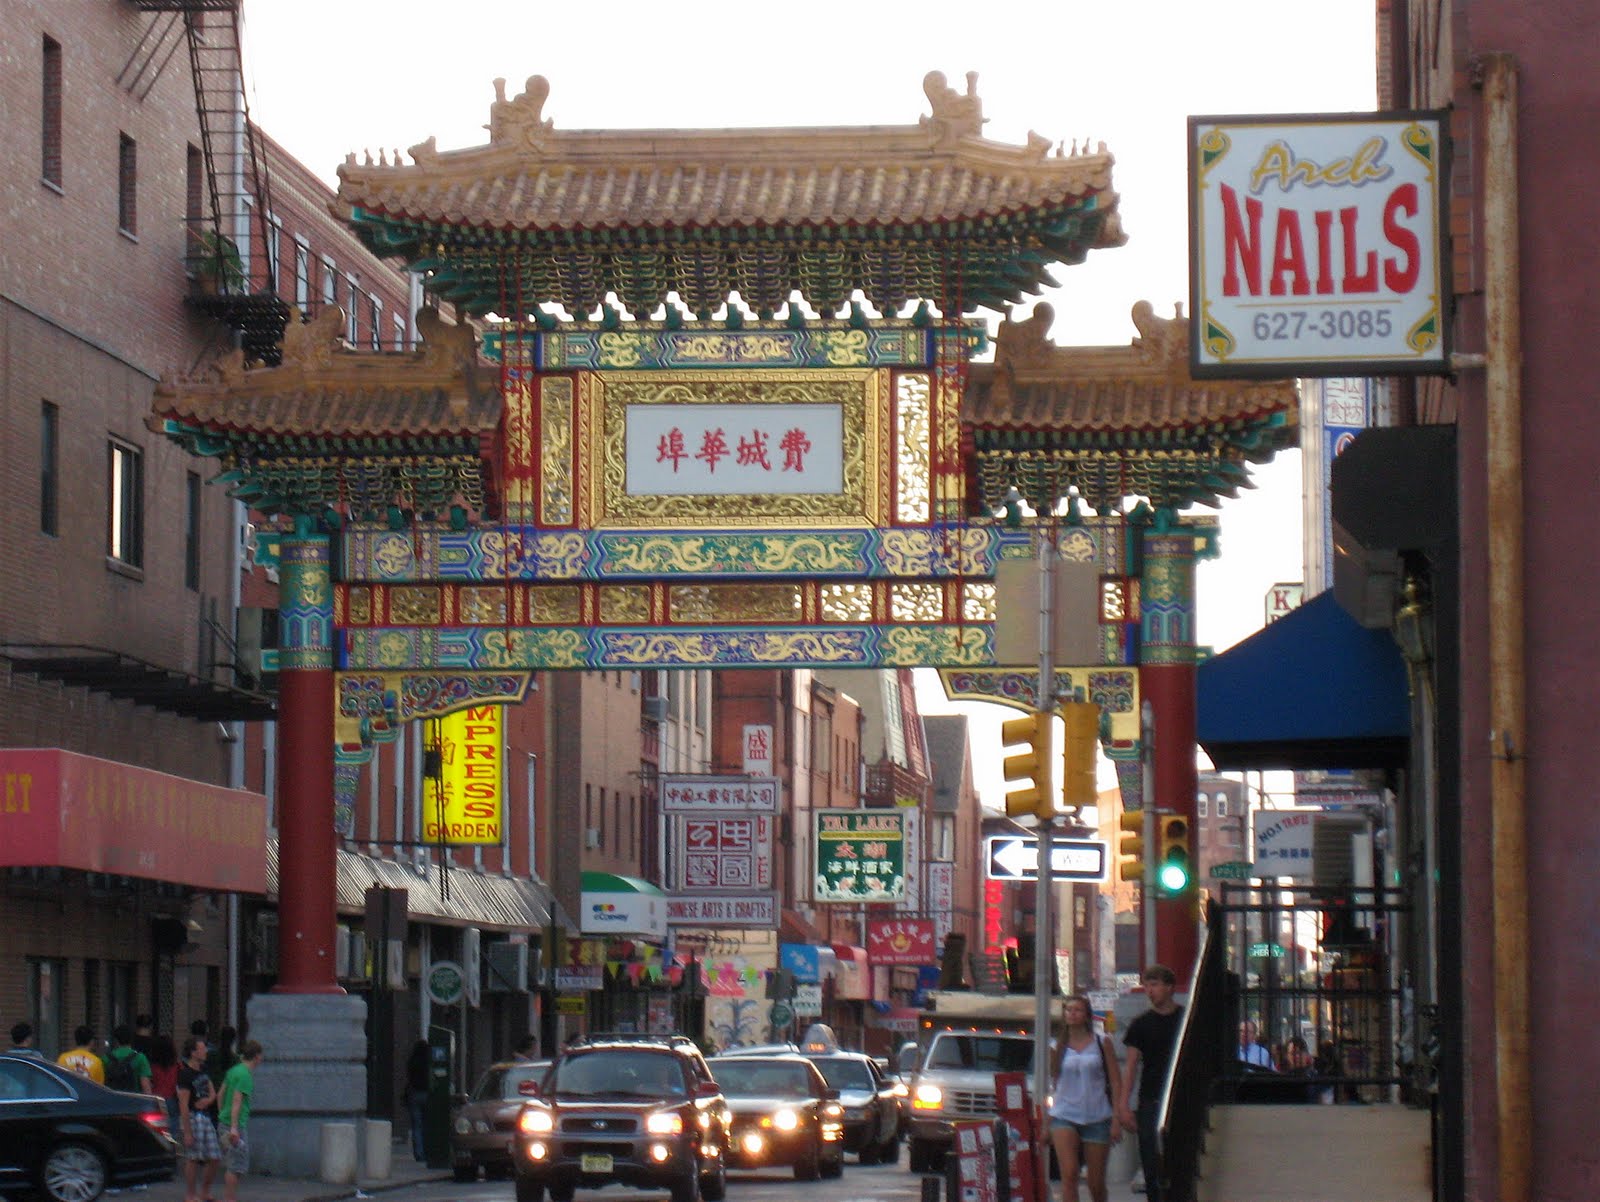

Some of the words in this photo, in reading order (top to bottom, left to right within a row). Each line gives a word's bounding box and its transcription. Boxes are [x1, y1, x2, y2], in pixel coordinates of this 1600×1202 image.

[1250, 135, 1393, 195] Arch
[1219, 182, 1421, 297] NAILS
[1253, 309, 1392, 341] 627-3085
[464, 705, 496, 818] MPRESS
[0, 773, 32, 813] ET
[427, 824, 498, 838] GARDEN
[822, 815, 849, 831] TAI
[856, 815, 900, 831] LAKE
[702, 902, 723, 918] ARTS
[726, 902, 733, 918] &
[735, 902, 766, 918] CRAFTS
